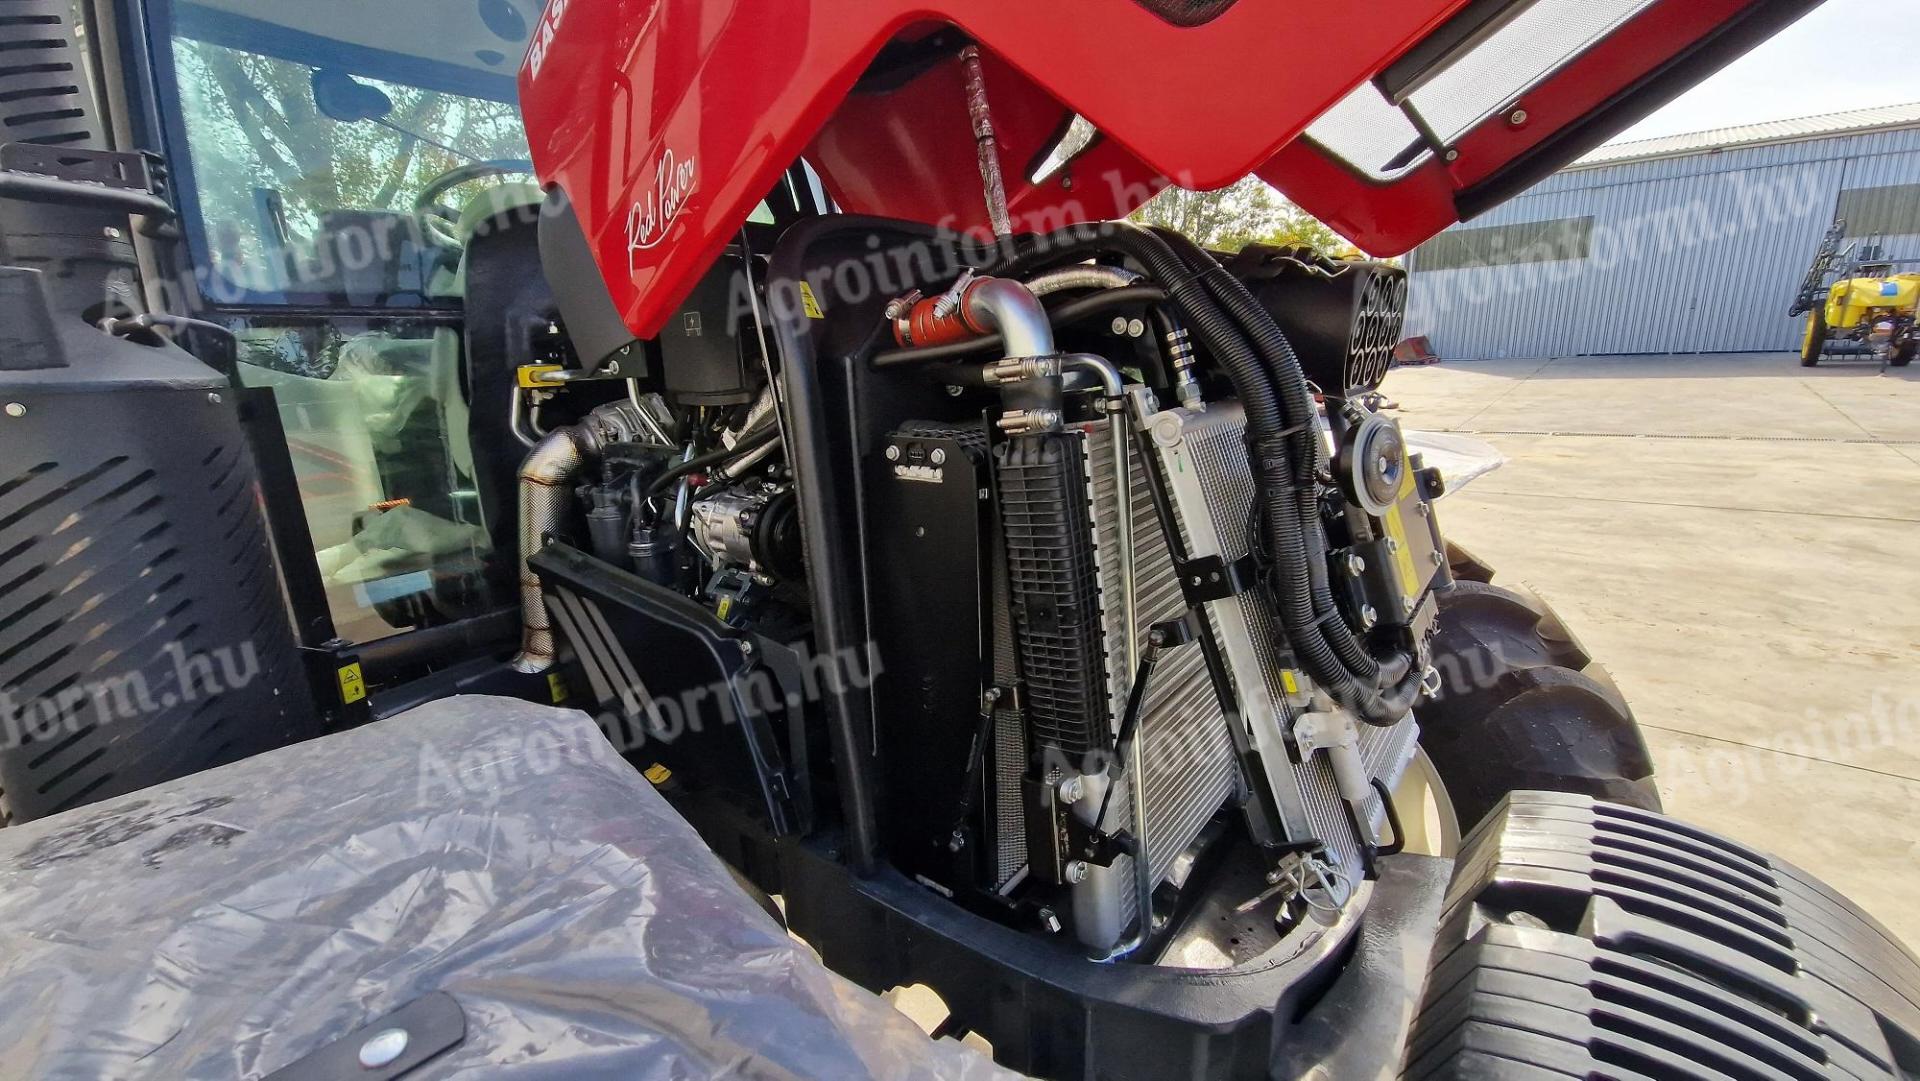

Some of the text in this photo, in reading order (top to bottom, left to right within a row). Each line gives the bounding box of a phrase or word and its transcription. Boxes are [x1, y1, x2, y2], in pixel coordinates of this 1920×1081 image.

[530, 0, 568, 83] BAS
[624, 148, 696, 278] Red Power
